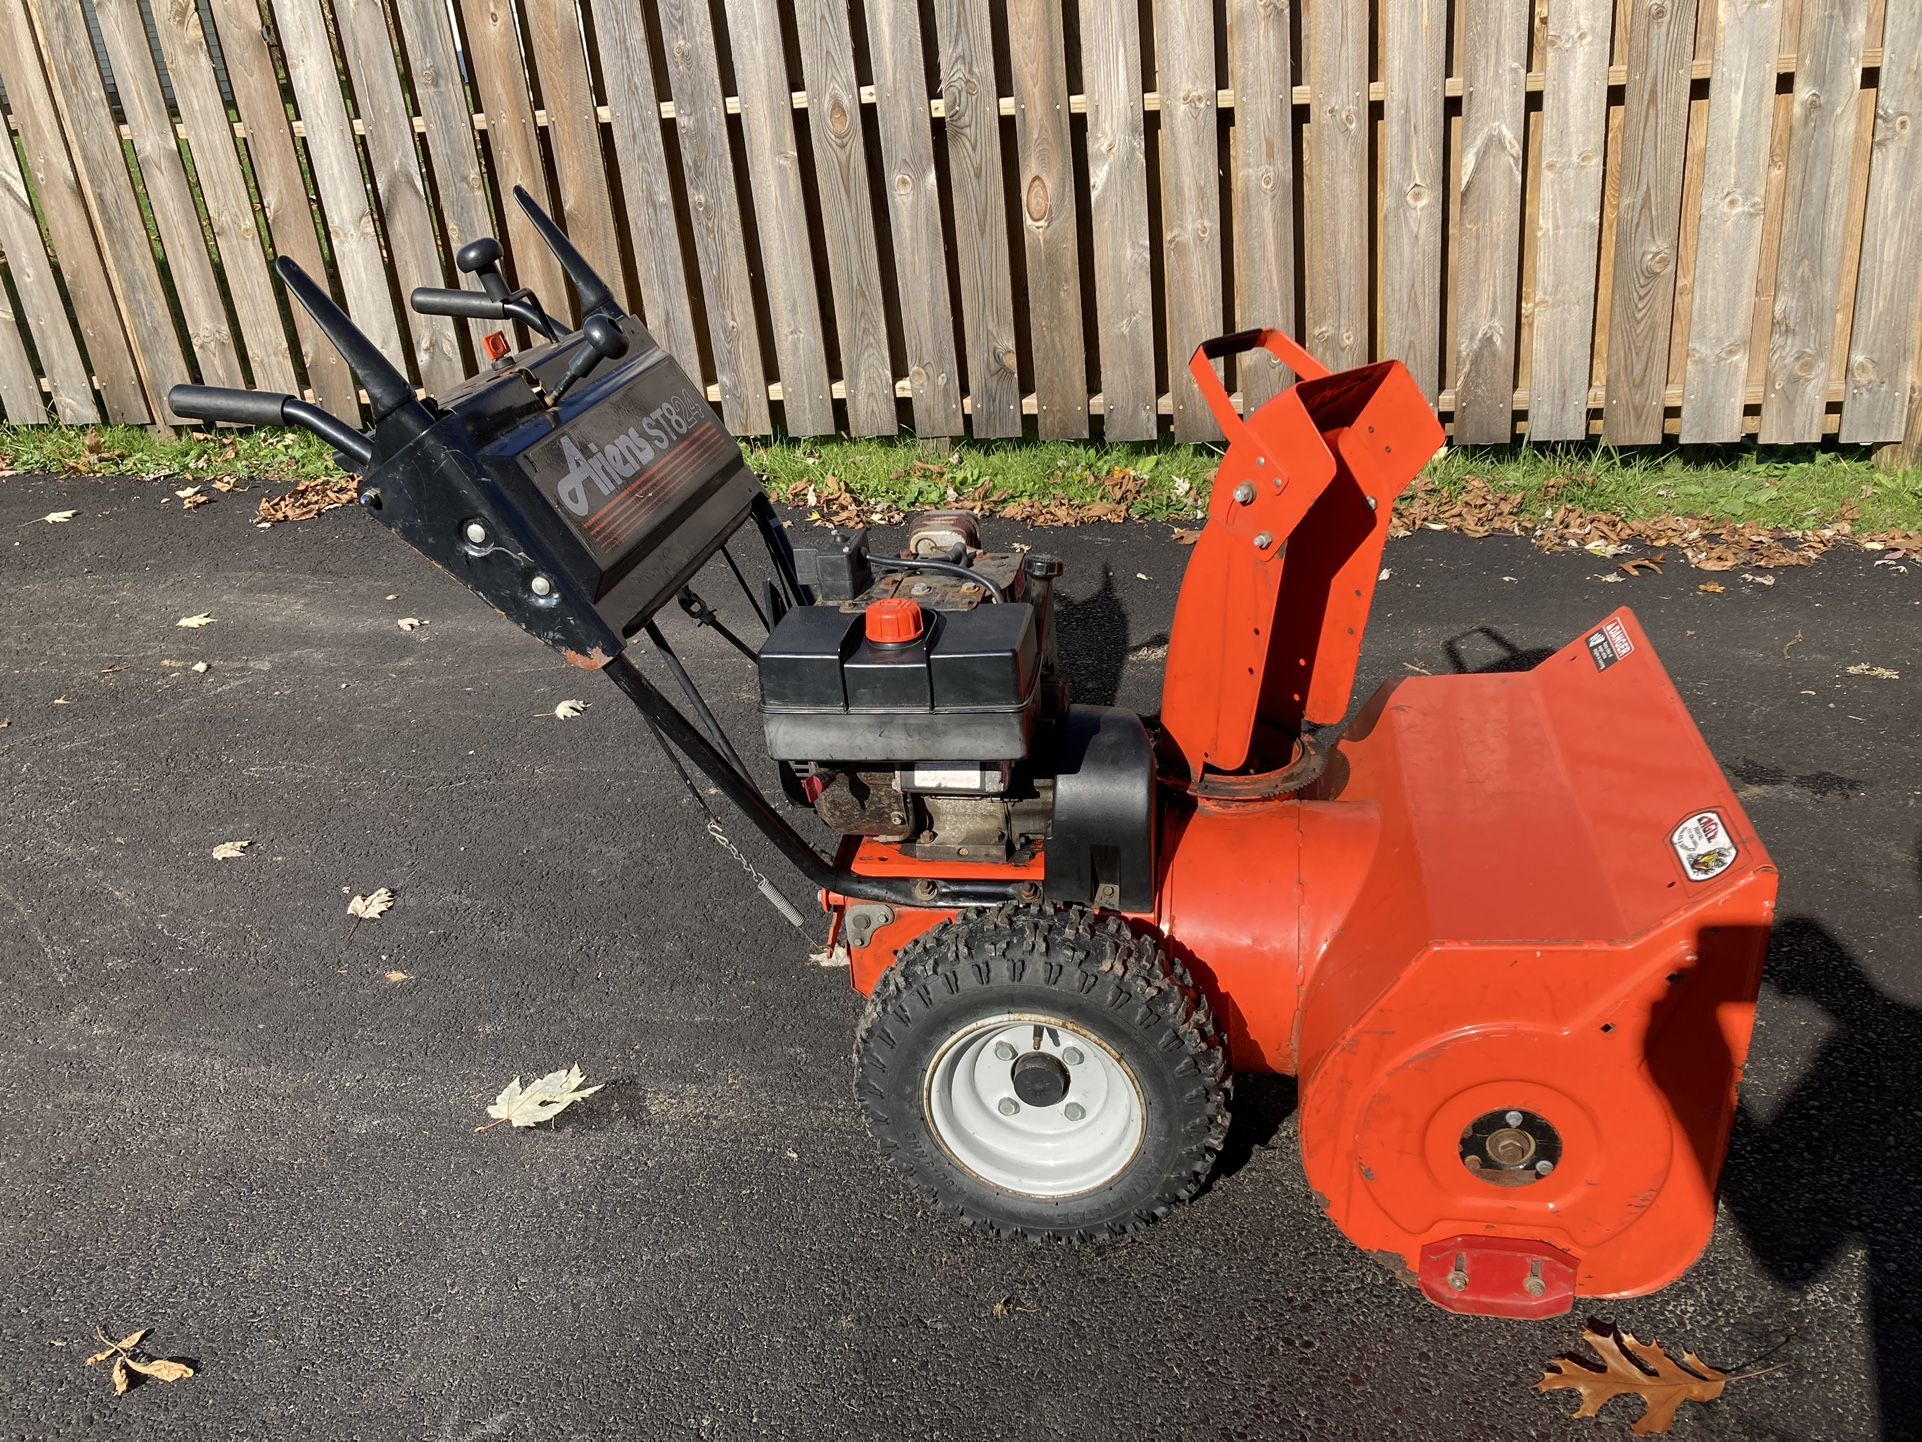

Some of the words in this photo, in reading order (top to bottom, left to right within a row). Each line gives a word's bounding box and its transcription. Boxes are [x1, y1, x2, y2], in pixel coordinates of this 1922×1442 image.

[557, 426, 655, 517] Ariens
[641, 388, 705, 450] ST824
[1608, 625, 1631, 657] DANGER
[1697, 816, 1719, 844] EAGLE
